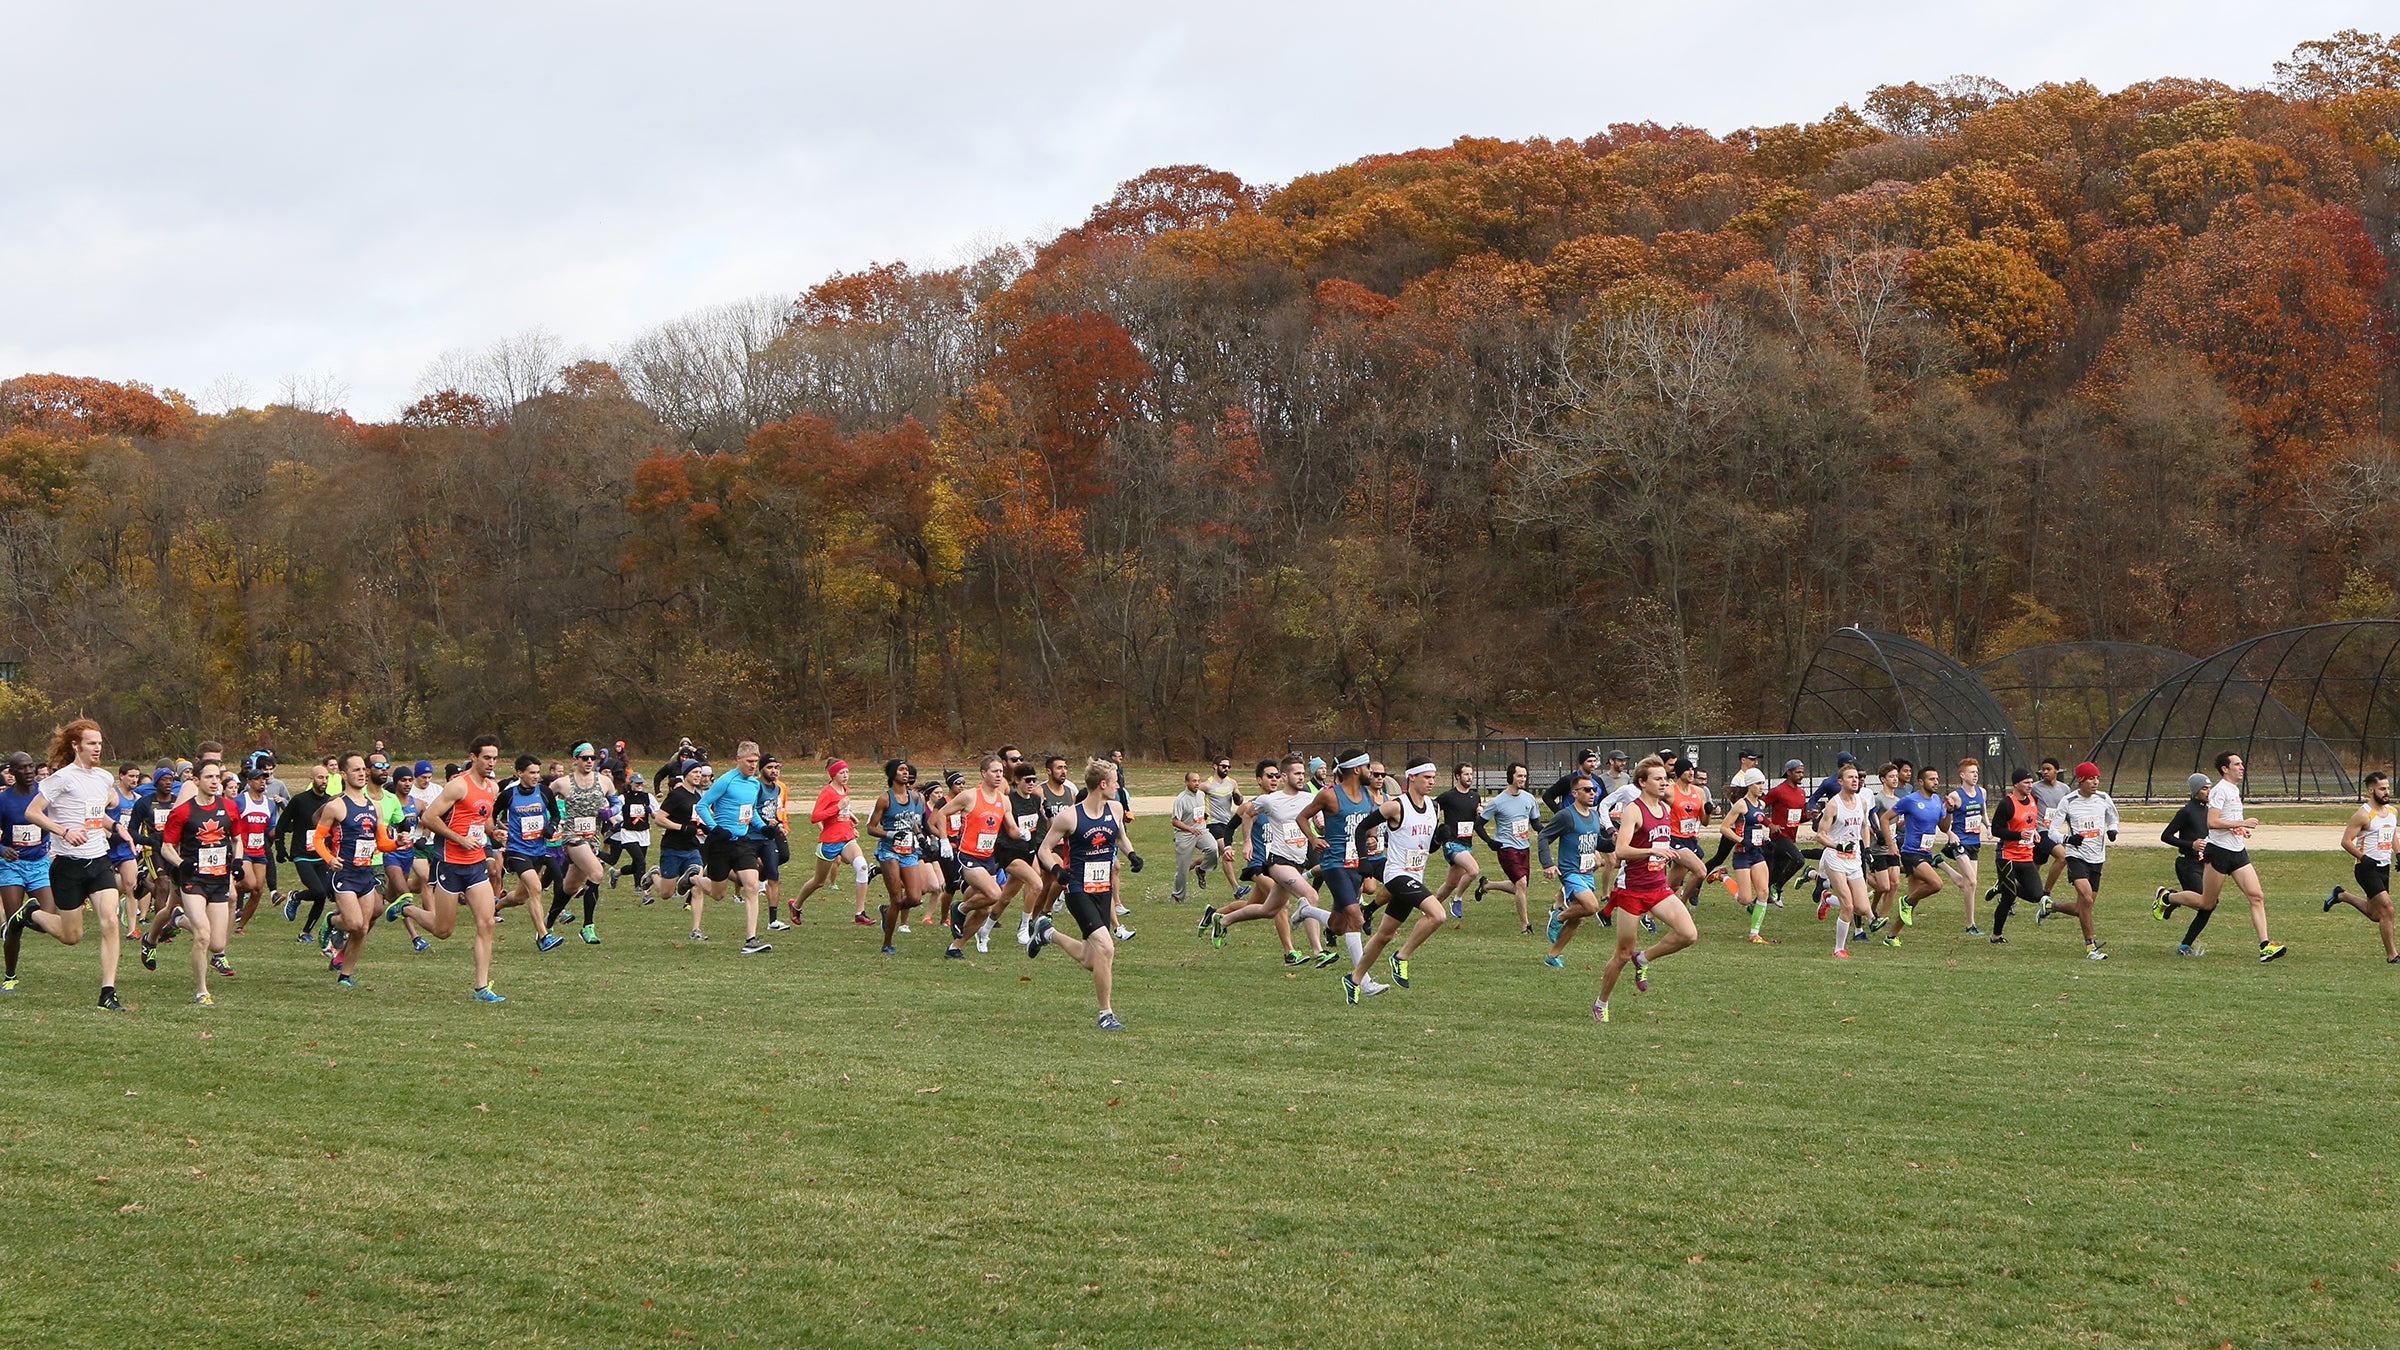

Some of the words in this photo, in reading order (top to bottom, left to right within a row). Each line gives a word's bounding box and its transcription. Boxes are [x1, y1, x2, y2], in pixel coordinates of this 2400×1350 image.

[247, 815, 267, 824] WSX
[1844, 817, 1861, 827] NYAC
[580, 822, 591, 831] 159
[1411, 824, 1432, 837] NYAC
[22, 831, 32, 842] 21
[1083, 826, 1101, 839] CENTRAL
[1102, 826, 1114, 836] PARK
[207, 854, 219, 865] 49
[1092, 869, 1105, 881] 112
